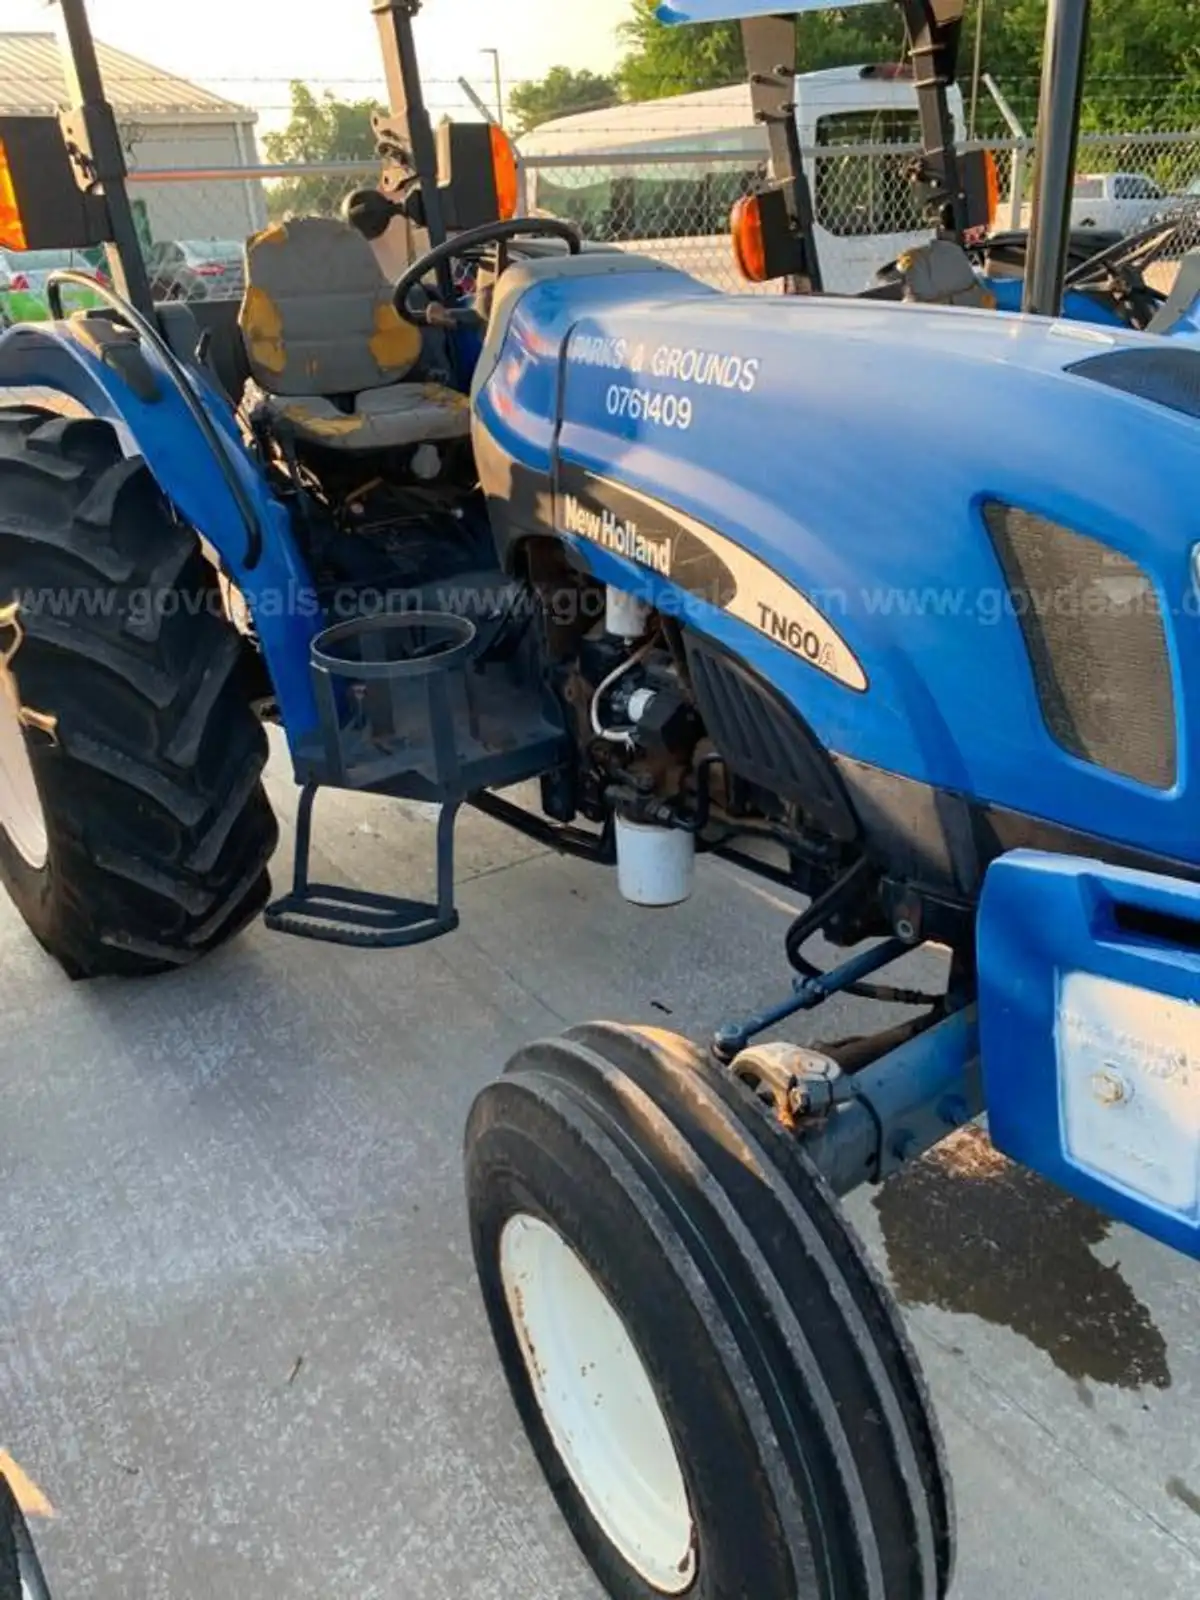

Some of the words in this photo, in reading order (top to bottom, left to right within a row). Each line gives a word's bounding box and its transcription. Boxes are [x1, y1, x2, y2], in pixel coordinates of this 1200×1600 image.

[652, 346, 759, 393] GROUNDS
[606, 384, 693, 430] 0761409
[564, 494, 601, 541] New
[601, 509, 671, 577] Holland
[757, 601, 838, 673] TN60A
